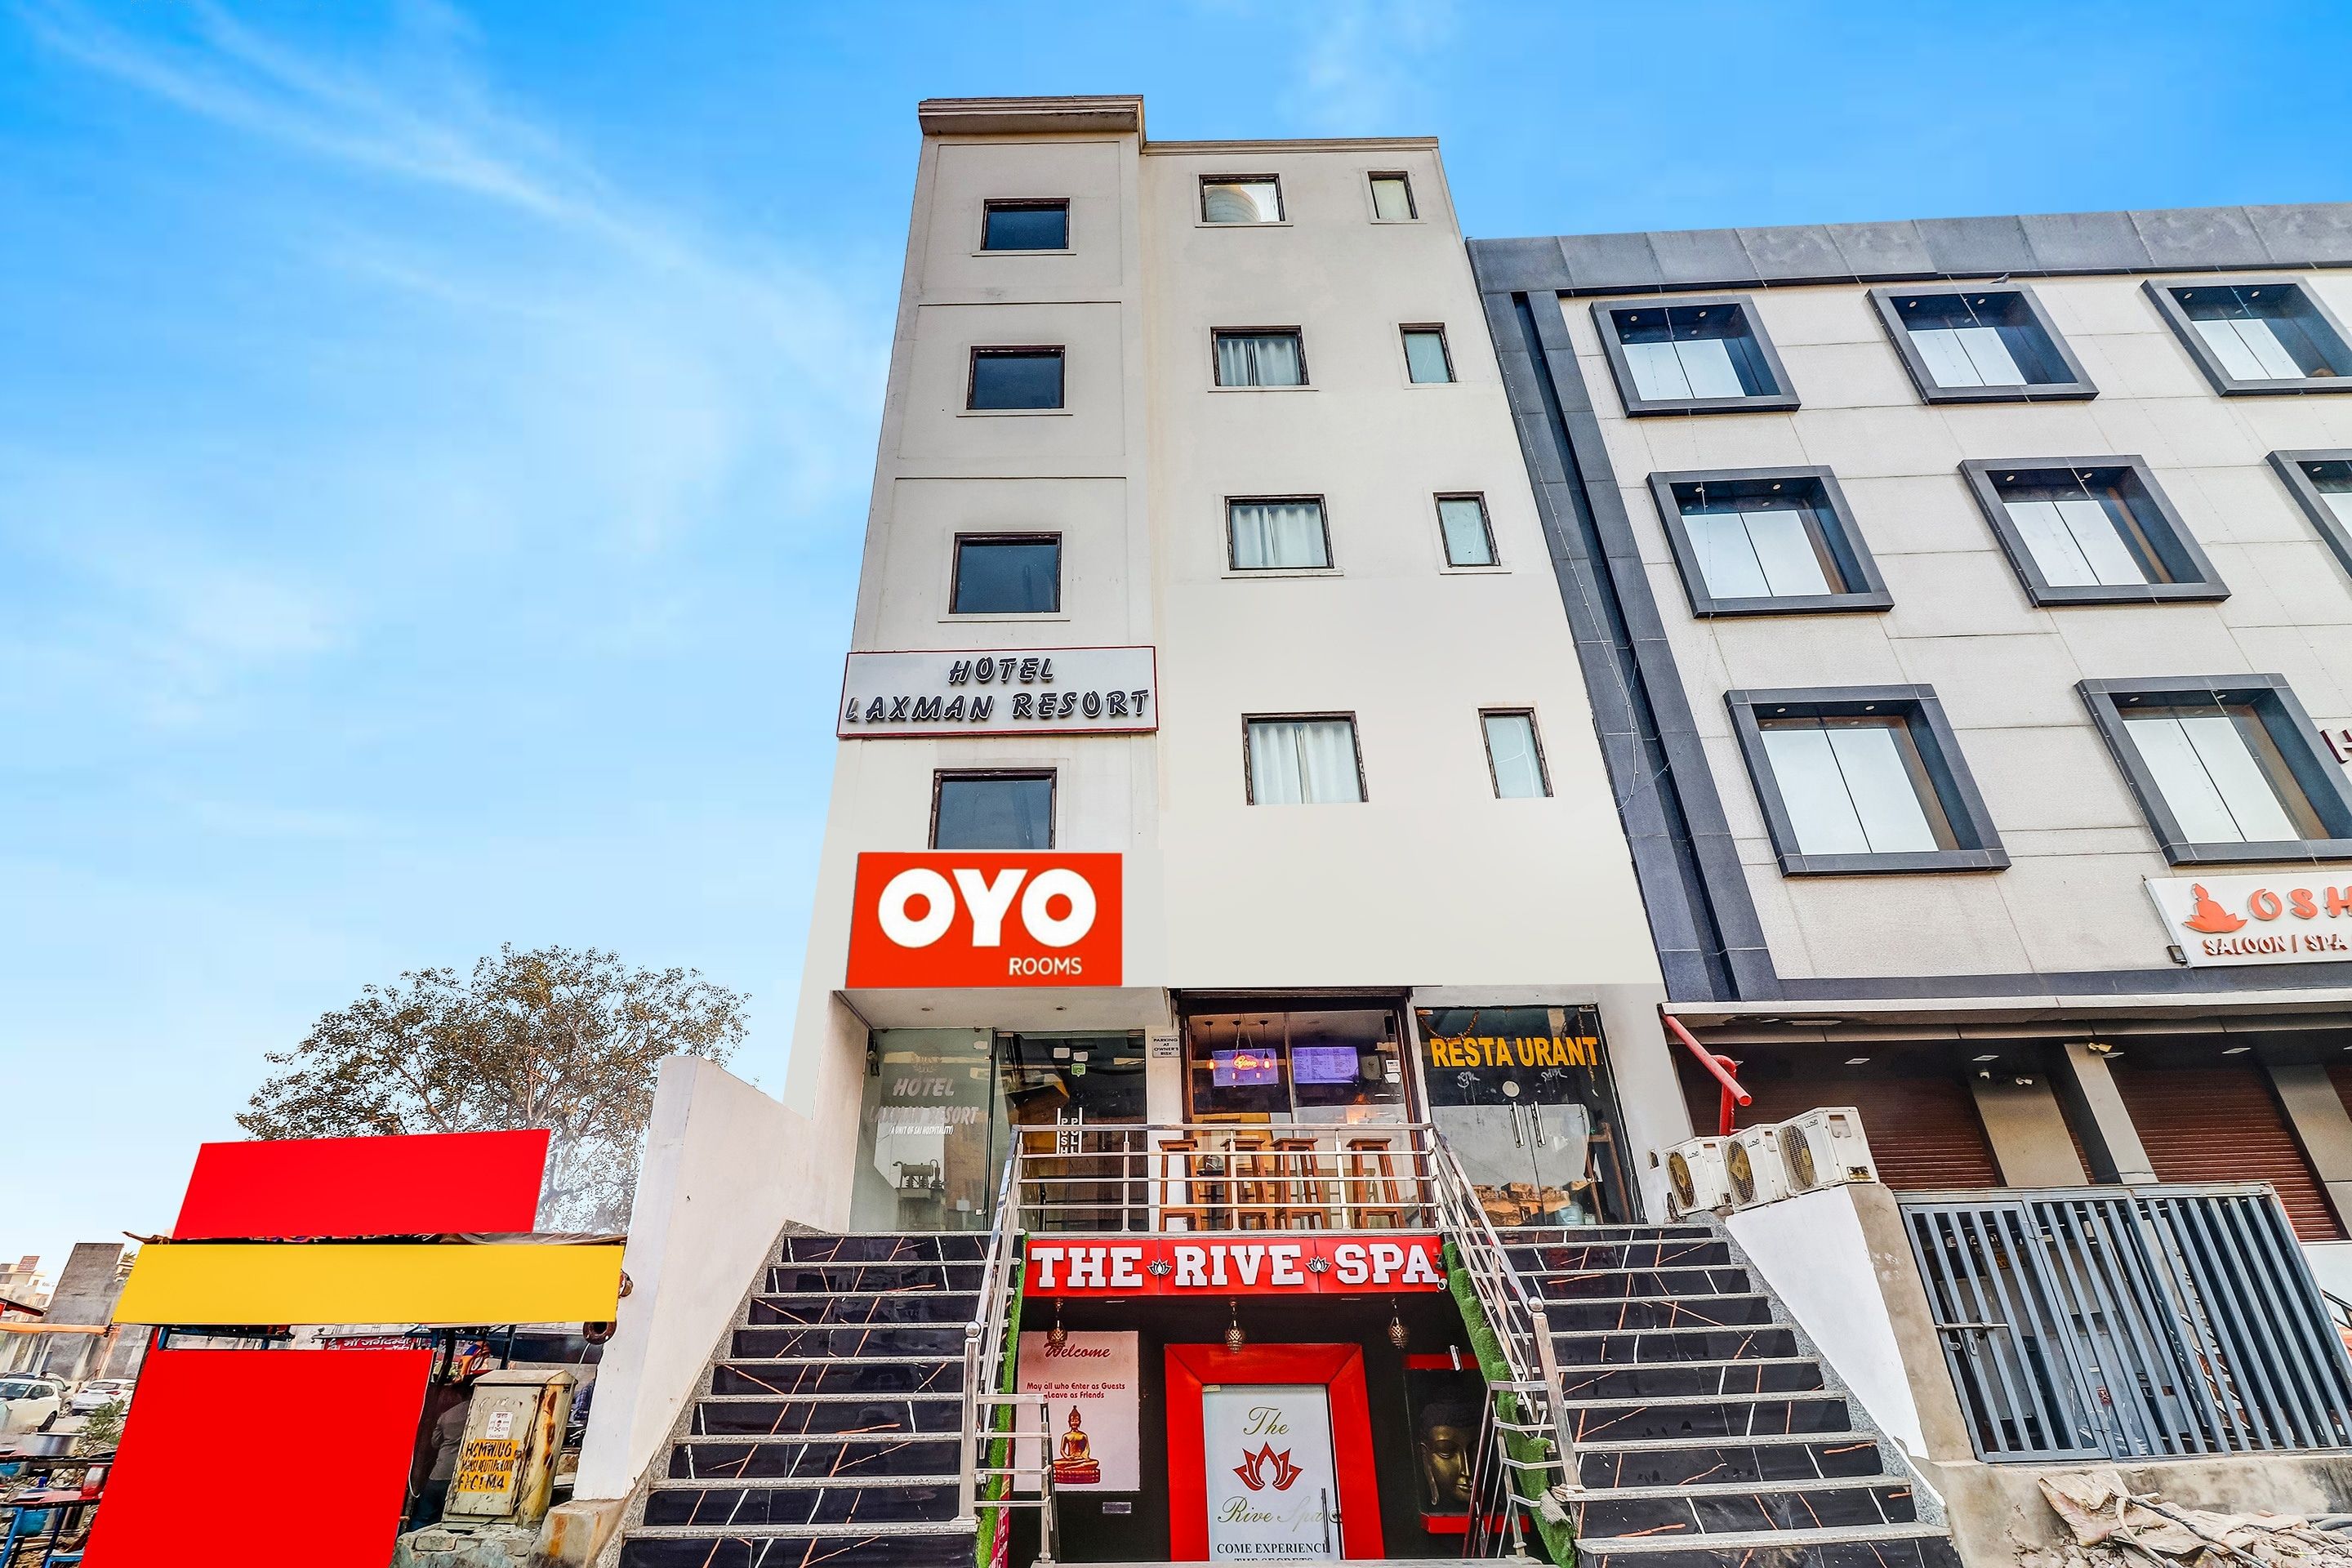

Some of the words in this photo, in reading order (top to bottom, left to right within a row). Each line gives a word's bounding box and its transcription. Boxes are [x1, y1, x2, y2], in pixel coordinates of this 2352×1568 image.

[947, 657, 1054, 684] HOTEL
[844, 695, 993, 723] LAXMAN
[1012, 688, 1149, 719] RESORT
[878, 868, 1096, 948] OYO
[2203, 937, 2287, 956] SALOON
[2305, 933, 2349, 952] SPA
[1009, 957, 1082, 976] ROOMS
[893, 1077, 955, 1097] HOTEL
[929, 1106, 979, 1125] RESORT
[1031, 1247, 1143, 1288] THE
[1174, 1245, 1305, 1286] RIVE
[1334, 1243, 1440, 1285] SPA
[1044, 1343, 1111, 1357] Welcome
[1027, 1382, 1042, 1391] May
[1048, 1391, 1067, 1399] Leave
[1080, 1391, 1104, 1399] Friends
[1243, 1406, 1290, 1435] The
[1217, 1496, 1274, 1523] Rive
[1217, 1543, 1252, 1554] COME
